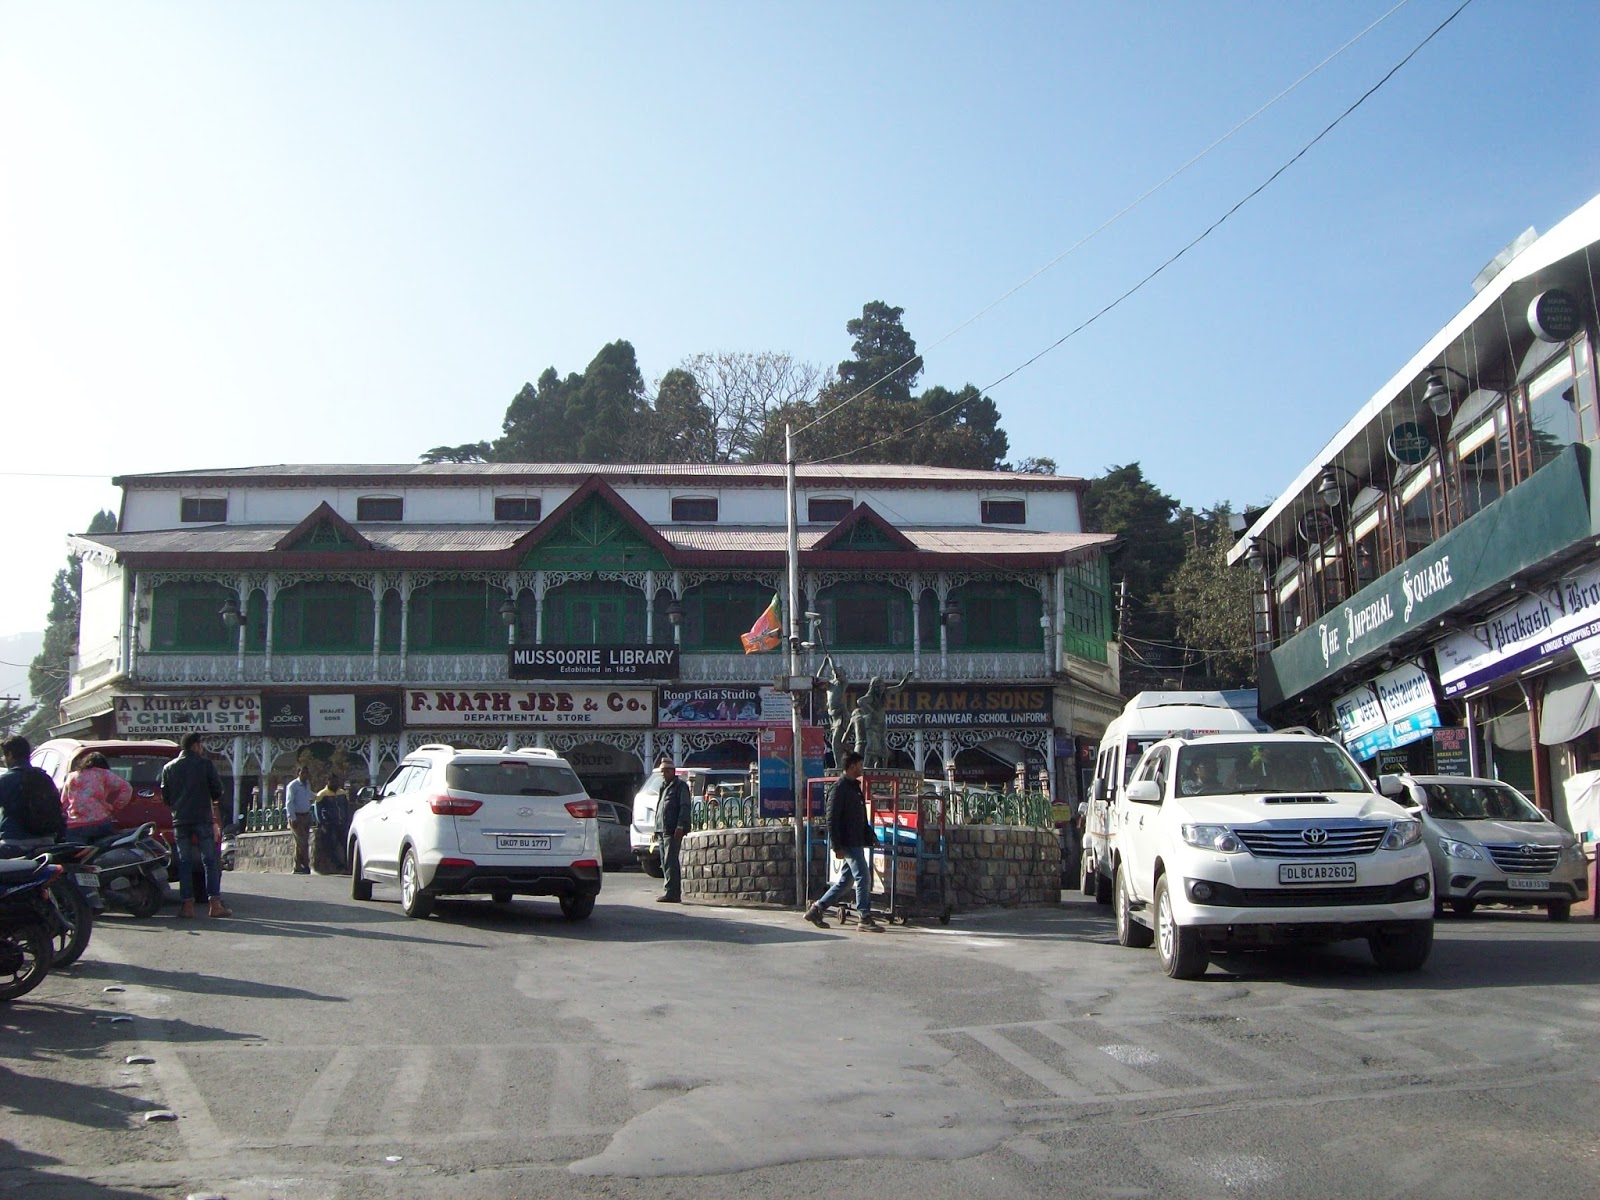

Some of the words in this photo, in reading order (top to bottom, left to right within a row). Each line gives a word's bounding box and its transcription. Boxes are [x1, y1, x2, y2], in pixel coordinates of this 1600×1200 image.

[1344, 594, 1394, 656] IMPERIAL
[1403, 555, 1453, 624] SQUARE
[1492, 599, 1552, 653] Prakash
[1565, 580, 1600, 616] Bro
[1563, 626, 1590, 646] SHOPPING
[514, 650, 601, 665] MUSSOORIE
[610, 650, 675, 664] LIBRARY
[436, 692, 512, 711] NATH
[518, 692, 574, 712] JEE
[582, 697, 598, 712] &
[606, 692, 648, 712] Co.
[664, 690, 692, 702] Roop
[694, 690, 718, 700] Kala
[721, 689, 756, 700] Studio
[916, 691, 968, 710] RAM
[970, 693, 984, 710] &
[986, 691, 1044, 710] SONS
[1356, 691, 1379, 722] Jeet
[1379, 672, 1431, 712] Restaurant
[120, 698, 138, 711] A.
[143, 697, 212, 711] Kumar
[218, 696, 230, 710] &
[234, 696, 260, 710] Co.
[136, 711, 244, 724] CHEMIST
[270, 715, 304, 723] JOCKEY
[464, 714, 548, 722] DEPARTMENTAL
[886, 714, 924, 724] HOSIERY
[925, 713, 972, 724] RAINWEAR
[978, 713, 1010, 723] SCHOOL
[1435, 730, 1454, 741] STEP
[1456, 728, 1466, 740] IN
[572, 752, 614, 766] Store
[1287, 866, 1354, 879] DL8CAB2602
